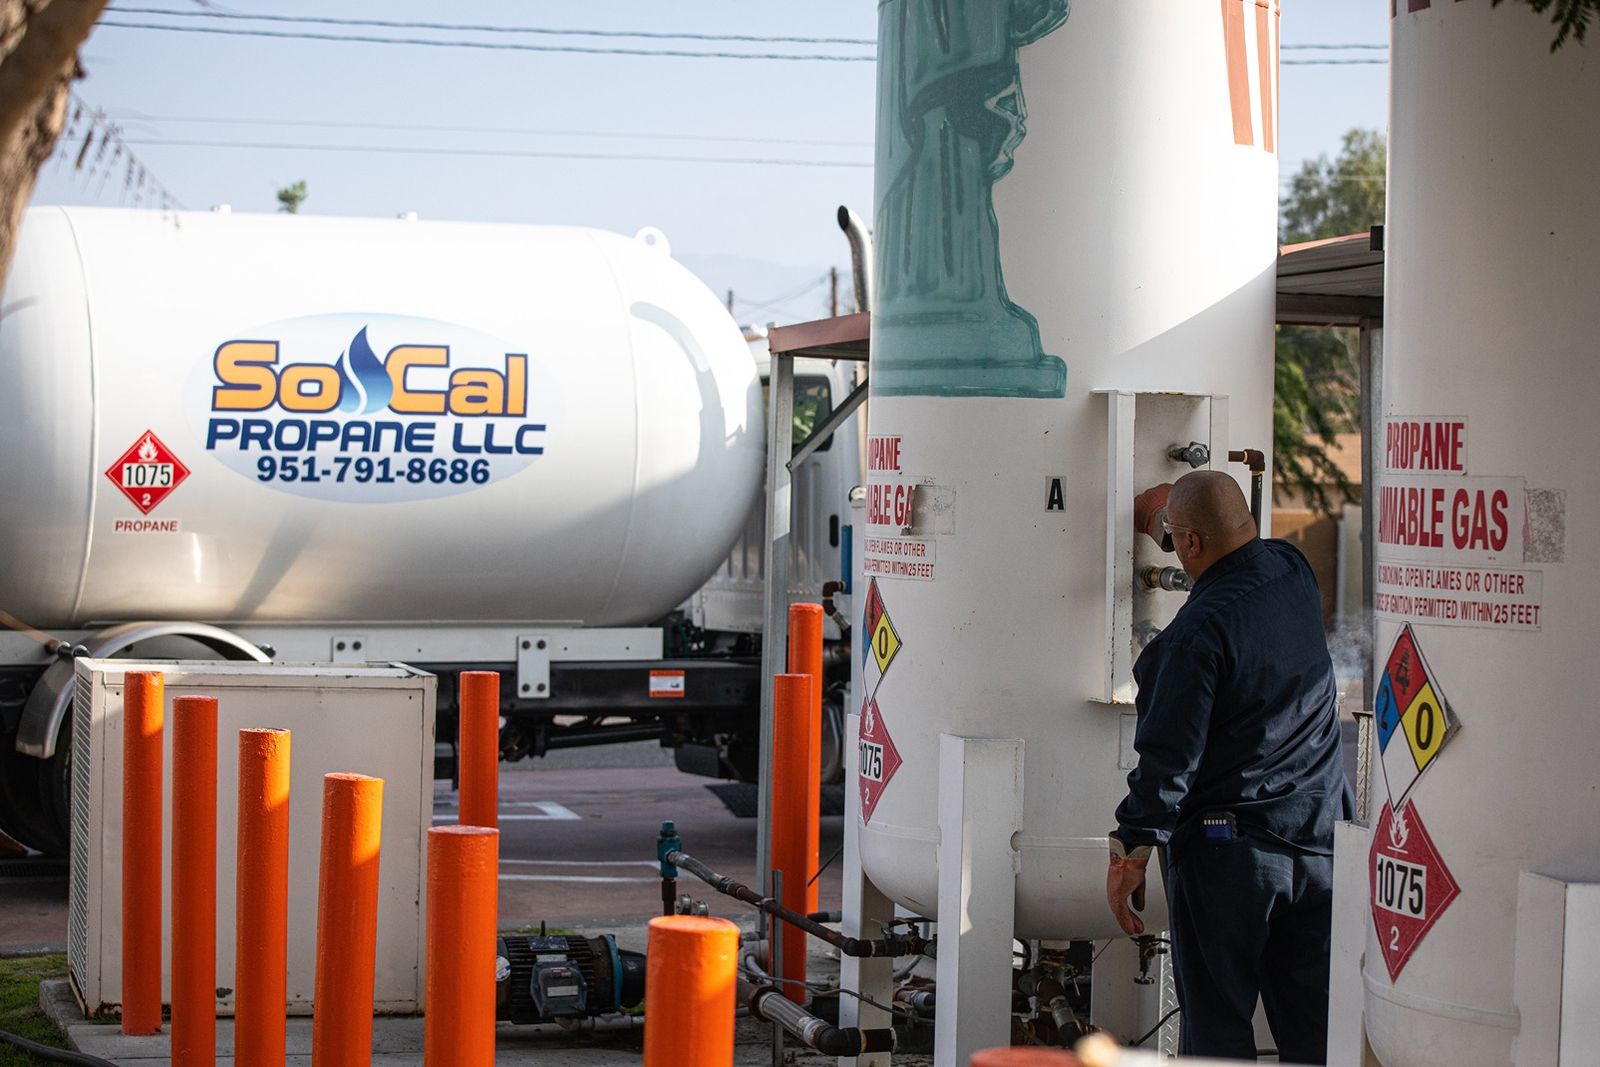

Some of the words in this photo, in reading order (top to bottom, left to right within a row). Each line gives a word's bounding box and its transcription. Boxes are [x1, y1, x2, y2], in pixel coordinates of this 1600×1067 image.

[205, 418, 436, 453] PROPANE
[452, 421, 547, 455] LLC
[1385, 421, 1464, 471] PROPANE
[868, 437, 901, 471] OPANE
[125, 464, 172, 487] 1075
[256, 455, 490, 485] 951-791-8686
[142, 493, 151, 507] 2
[866, 483, 892, 526] ABLE
[1047, 478, 1065, 510] A
[115, 520, 178, 532] PROPANE
[1451, 488, 1509, 551] GAS
[894, 542, 903, 556] OR
[903, 543, 926, 557] OTHER
[908, 563, 917, 577] 25
[917, 563, 935, 578] FEET
[1405, 567, 1424, 588] OPEN
[1425, 569, 1462, 591] FLAMES
[1465, 572, 1480, 592] OR
[1485, 573, 1525, 595] OTHER
[1414, 596, 1458, 620] PERMITTED
[1460, 601, 1493, 623] WITHIN
[1494, 604, 1508, 624] 25
[1510, 603, 1540, 625] FEET
[879, 627, 889, 660] 0
[1380, 684, 1390, 731] 2
[1415, 701, 1434, 751] 0
[859, 741, 882, 779] 1075
[864, 787, 870, 805] 2
[1377, 858, 1424, 915] 1075
[1390, 925, 1399, 951] 2
